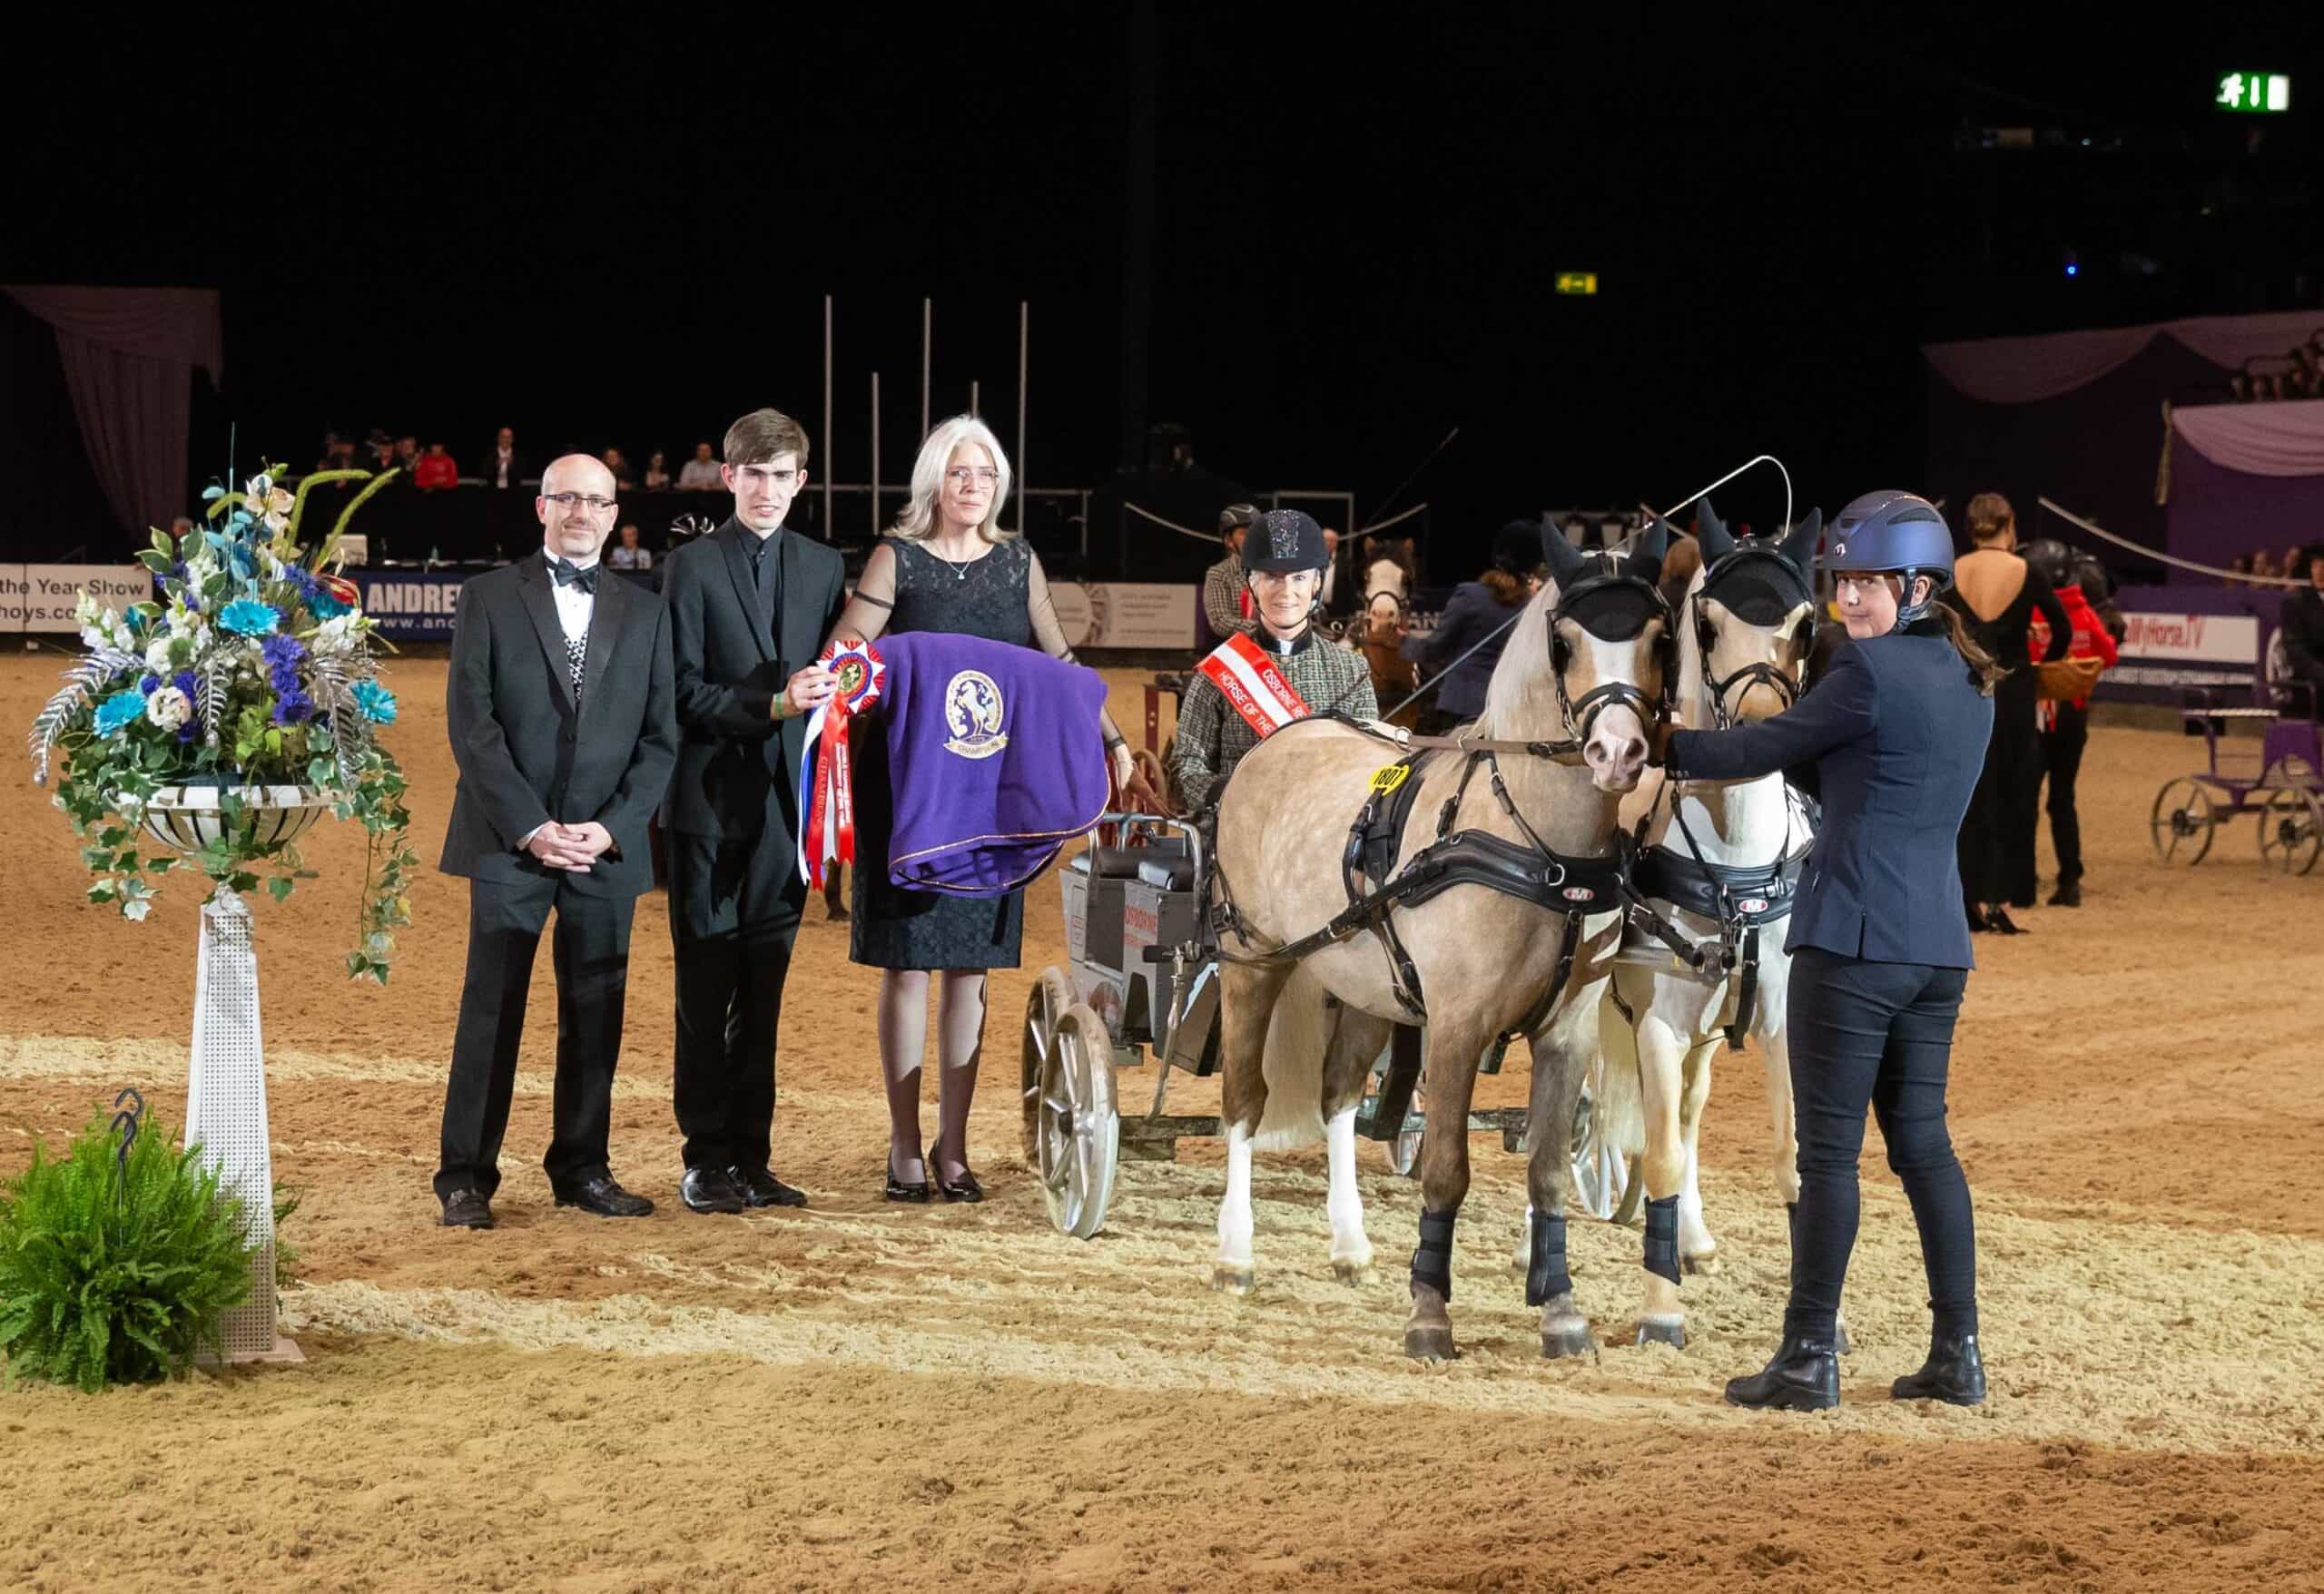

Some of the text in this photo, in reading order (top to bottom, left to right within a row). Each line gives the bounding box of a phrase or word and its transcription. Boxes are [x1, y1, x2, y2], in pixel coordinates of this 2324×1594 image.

[37, 578, 83, 595] Year
[89, 578, 144, 595] Show
[1219, 671, 1275, 734] HORSE OF THE
[1263, 668, 1297, 707] OSBORNE
[815, 756, 829, 823] CHAMPION
